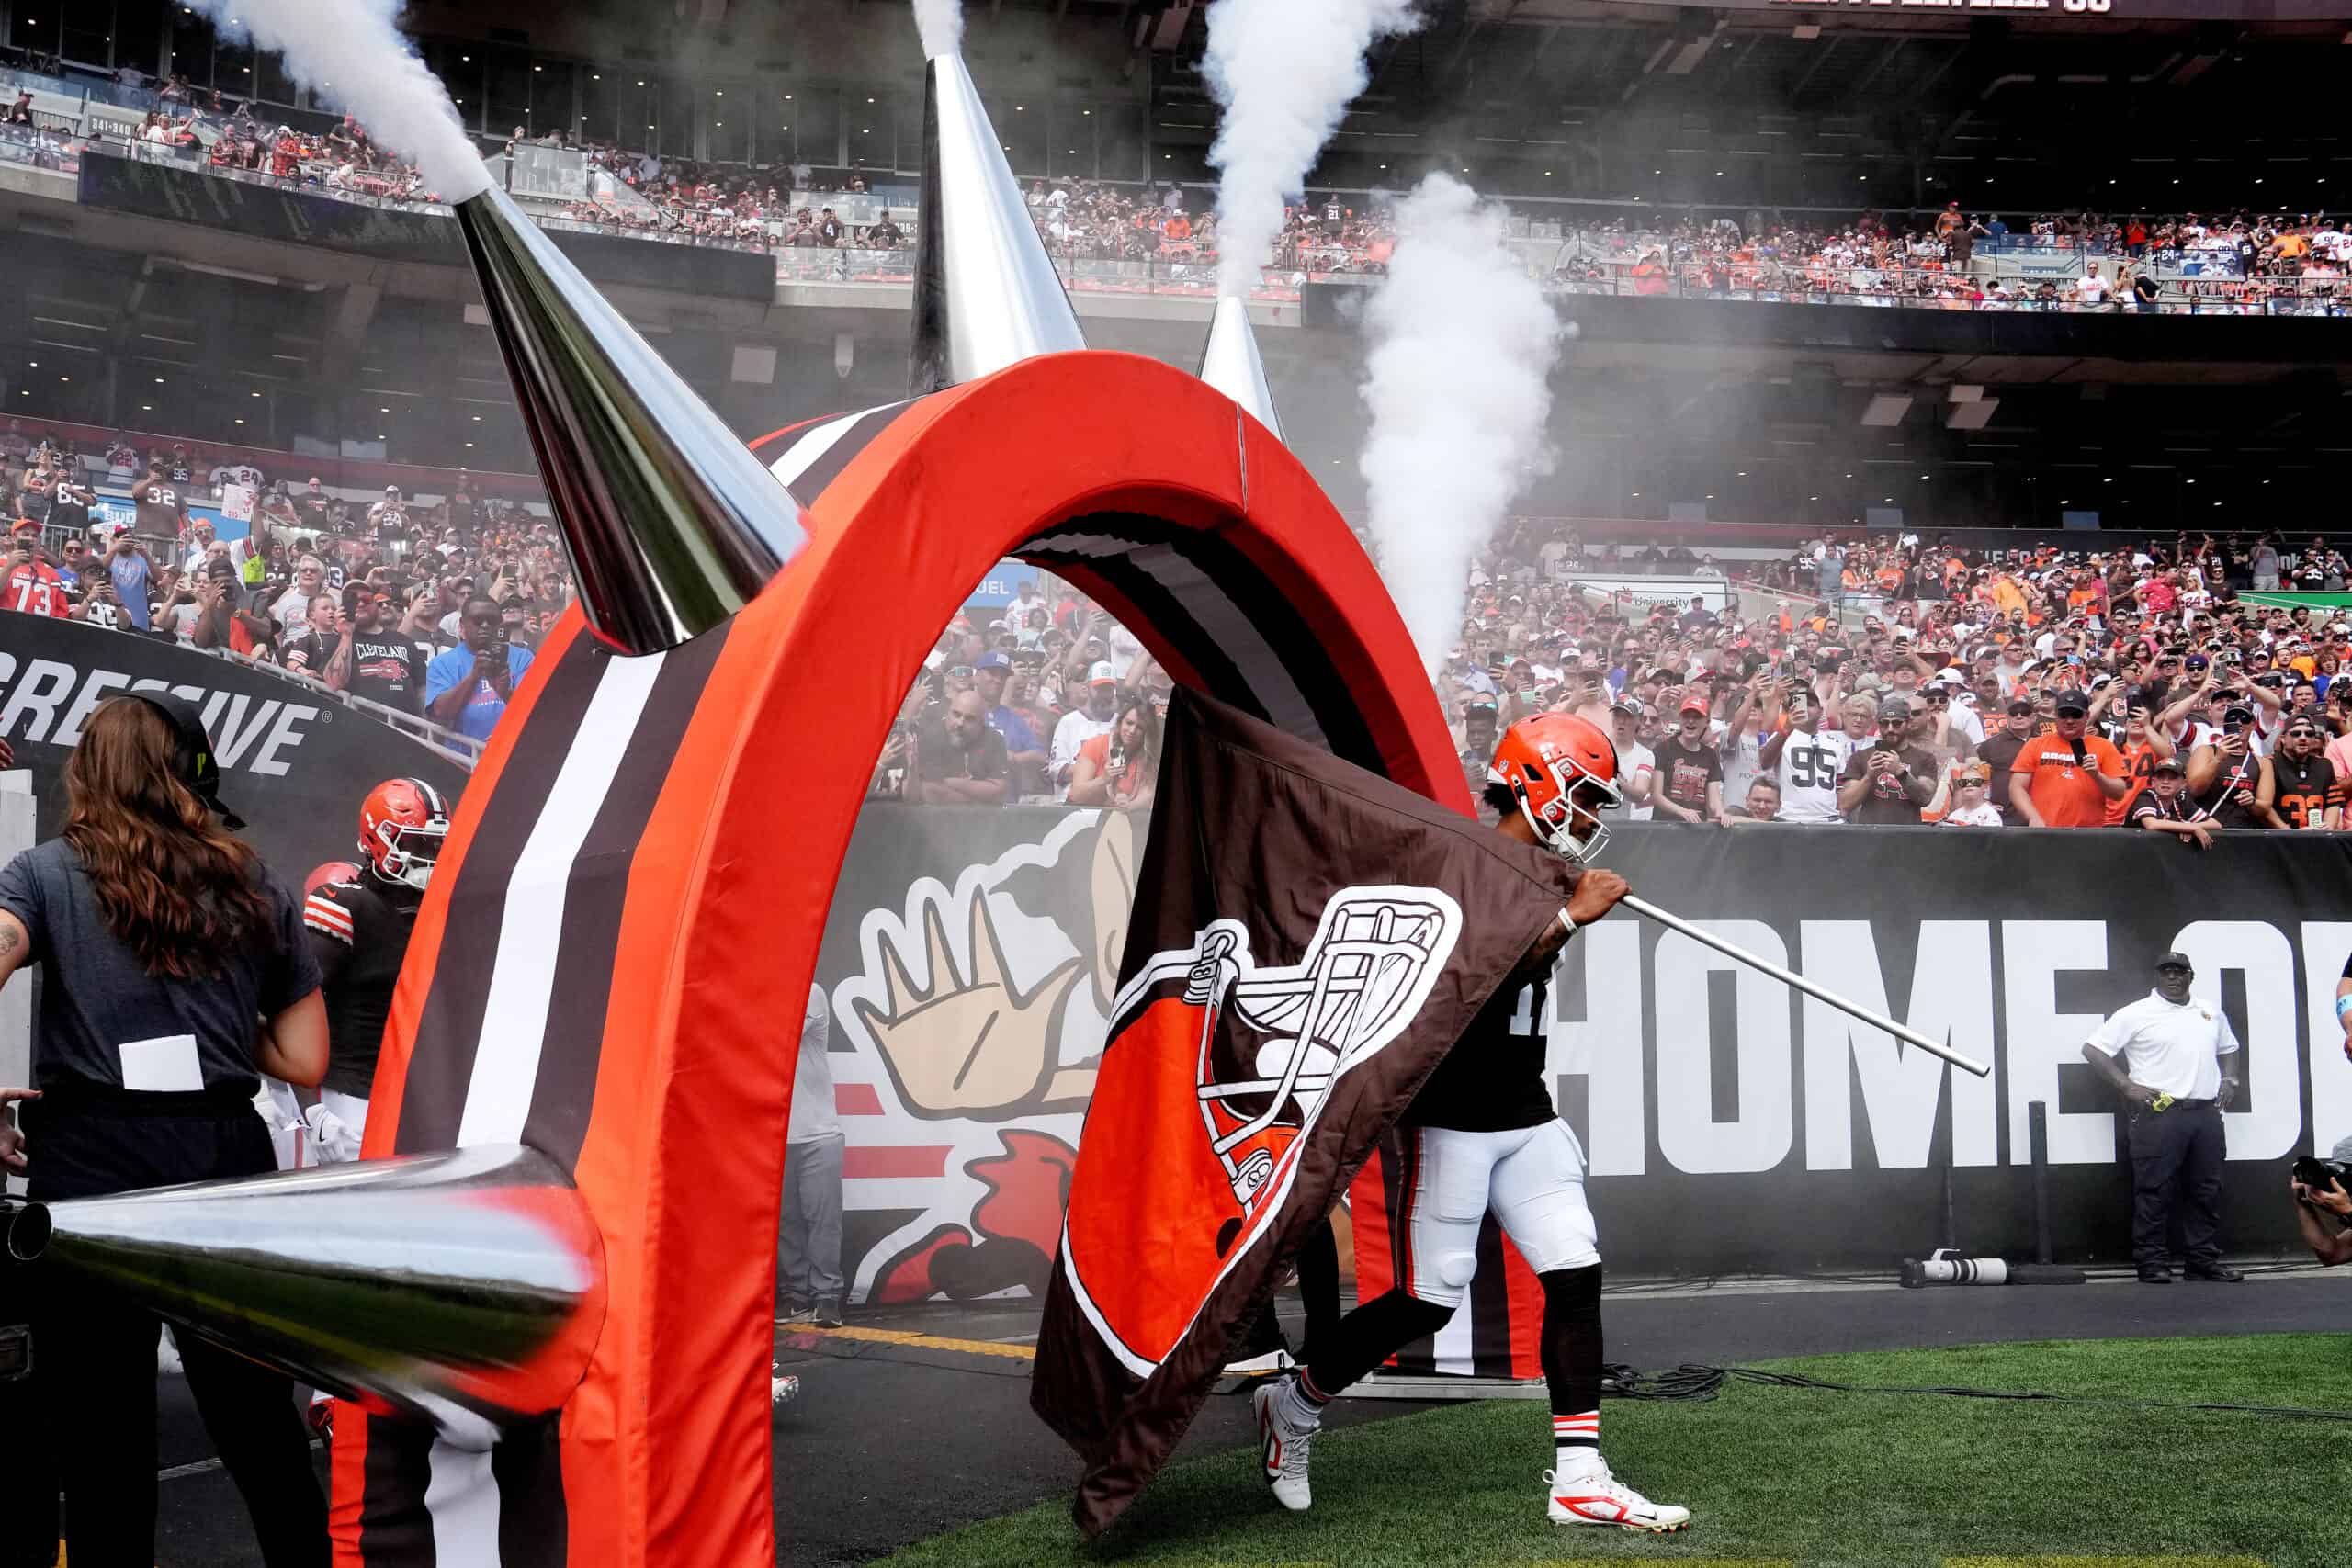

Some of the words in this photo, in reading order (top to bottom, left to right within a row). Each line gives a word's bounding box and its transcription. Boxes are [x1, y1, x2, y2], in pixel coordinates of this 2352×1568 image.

[147, 486, 175, 508] 32
[12, 578, 51, 618] 73
[356, 642, 410, 664] CLEVELAND
[1791, 746, 1837, 791] 95
[1541, 919, 2116, 1177] HOME
